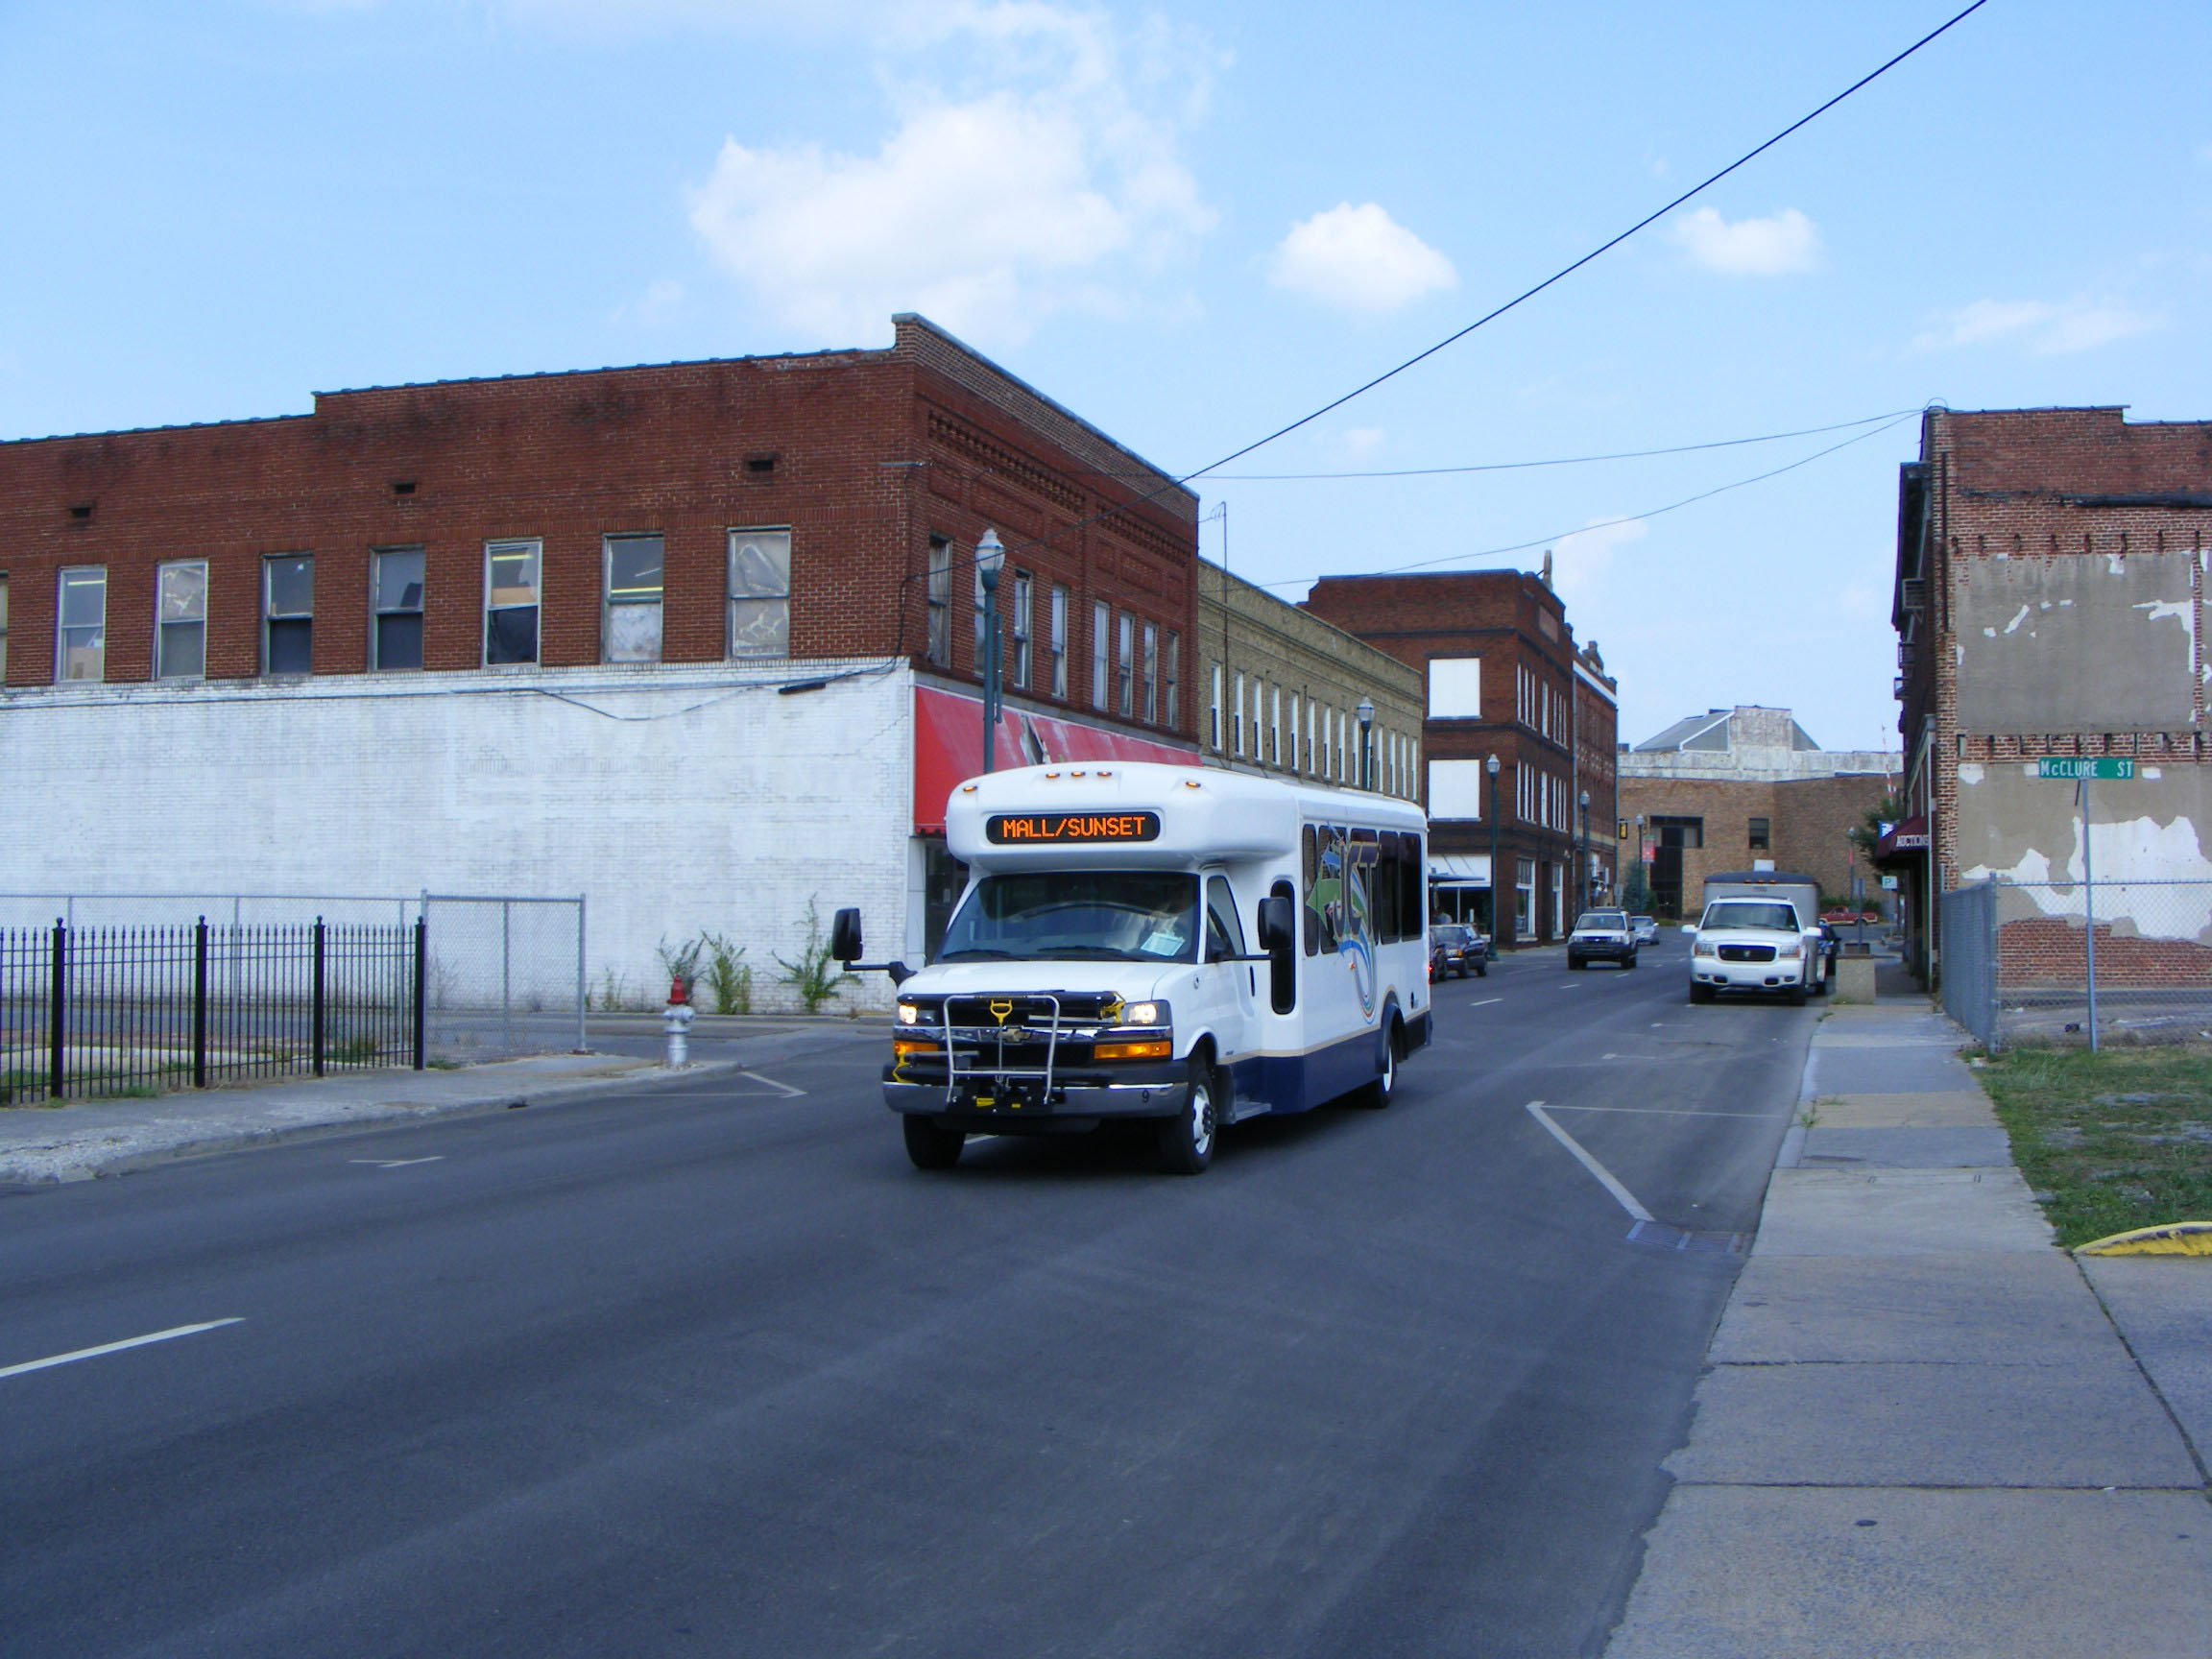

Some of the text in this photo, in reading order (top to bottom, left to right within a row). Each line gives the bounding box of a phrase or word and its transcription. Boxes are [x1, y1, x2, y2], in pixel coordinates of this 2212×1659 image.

[2040, 760, 2133, 777] McCLURE ST
[1002, 817, 1145, 838] MALL/SUNSET
[1142, 1090, 1150, 1103] 9
